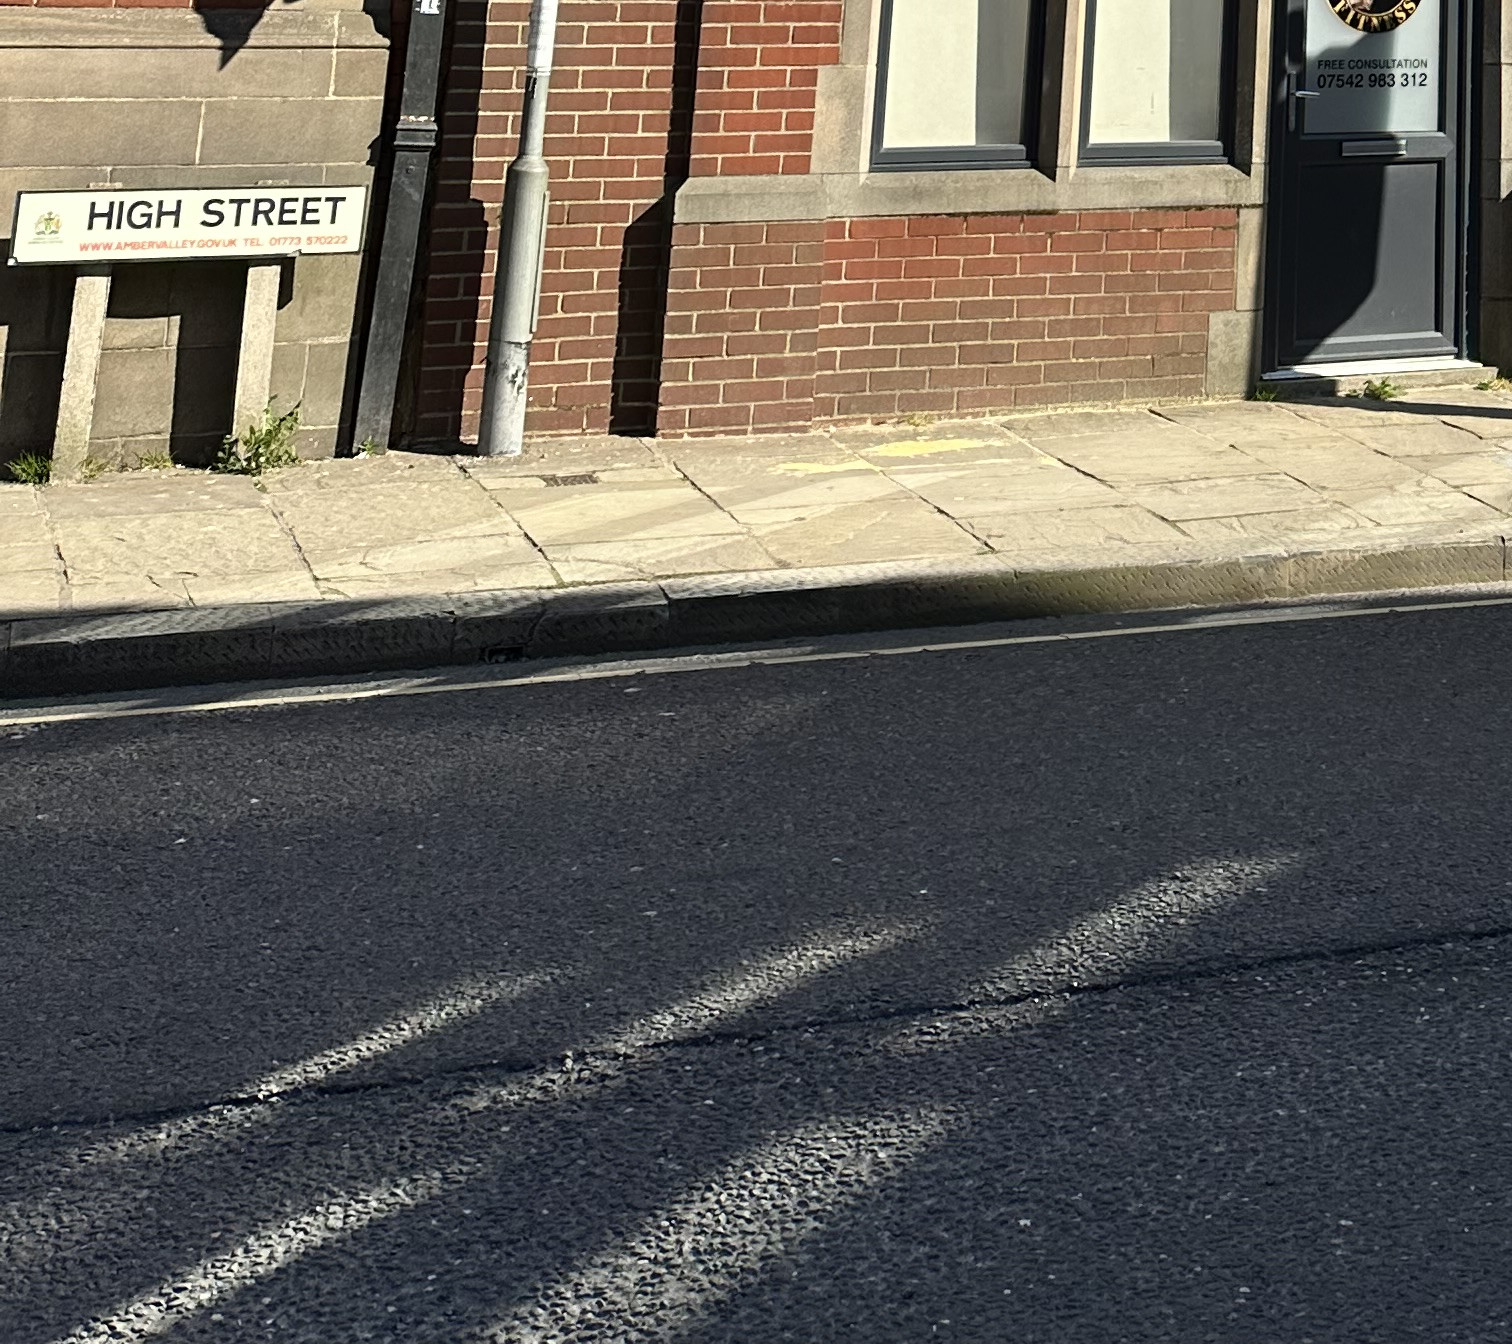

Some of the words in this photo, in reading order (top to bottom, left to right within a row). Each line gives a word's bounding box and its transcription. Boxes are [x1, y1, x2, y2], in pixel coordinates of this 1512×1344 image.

[1317, 59, 1346, 70] FREE
[1347, 58, 1428, 70] CONSULTATION
[1317, 73, 1364, 89] 07542
[1368, 73, 1396, 88] 983
[1400, 72, 1428, 87] 312
[87, 199, 183, 230] HIGH
[200, 196, 347, 228] STREET
[243, 237, 263, 247] TEL
[268, 236, 302, 247] 01773
[305, 235, 349, 246] 570222
